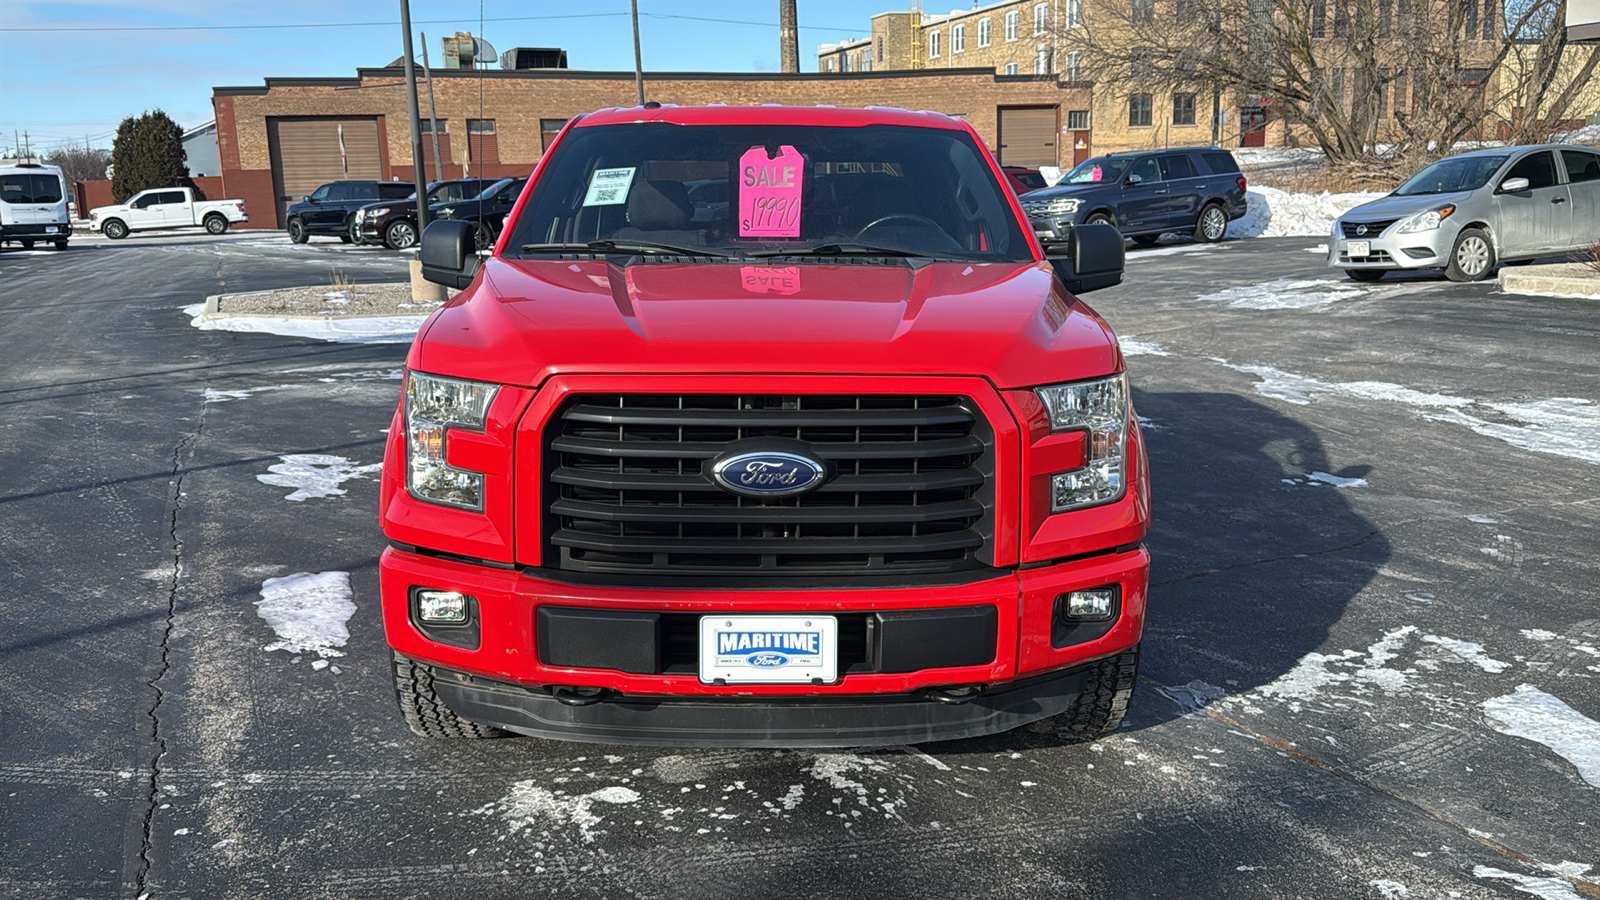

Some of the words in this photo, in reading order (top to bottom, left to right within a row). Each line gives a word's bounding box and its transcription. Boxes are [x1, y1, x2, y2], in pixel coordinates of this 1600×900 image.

[744, 166, 795, 187] SALE
[740, 461, 798, 485] Ford
[720, 633, 818, 654] MARITIME
[753, 655, 782, 666] Ford
